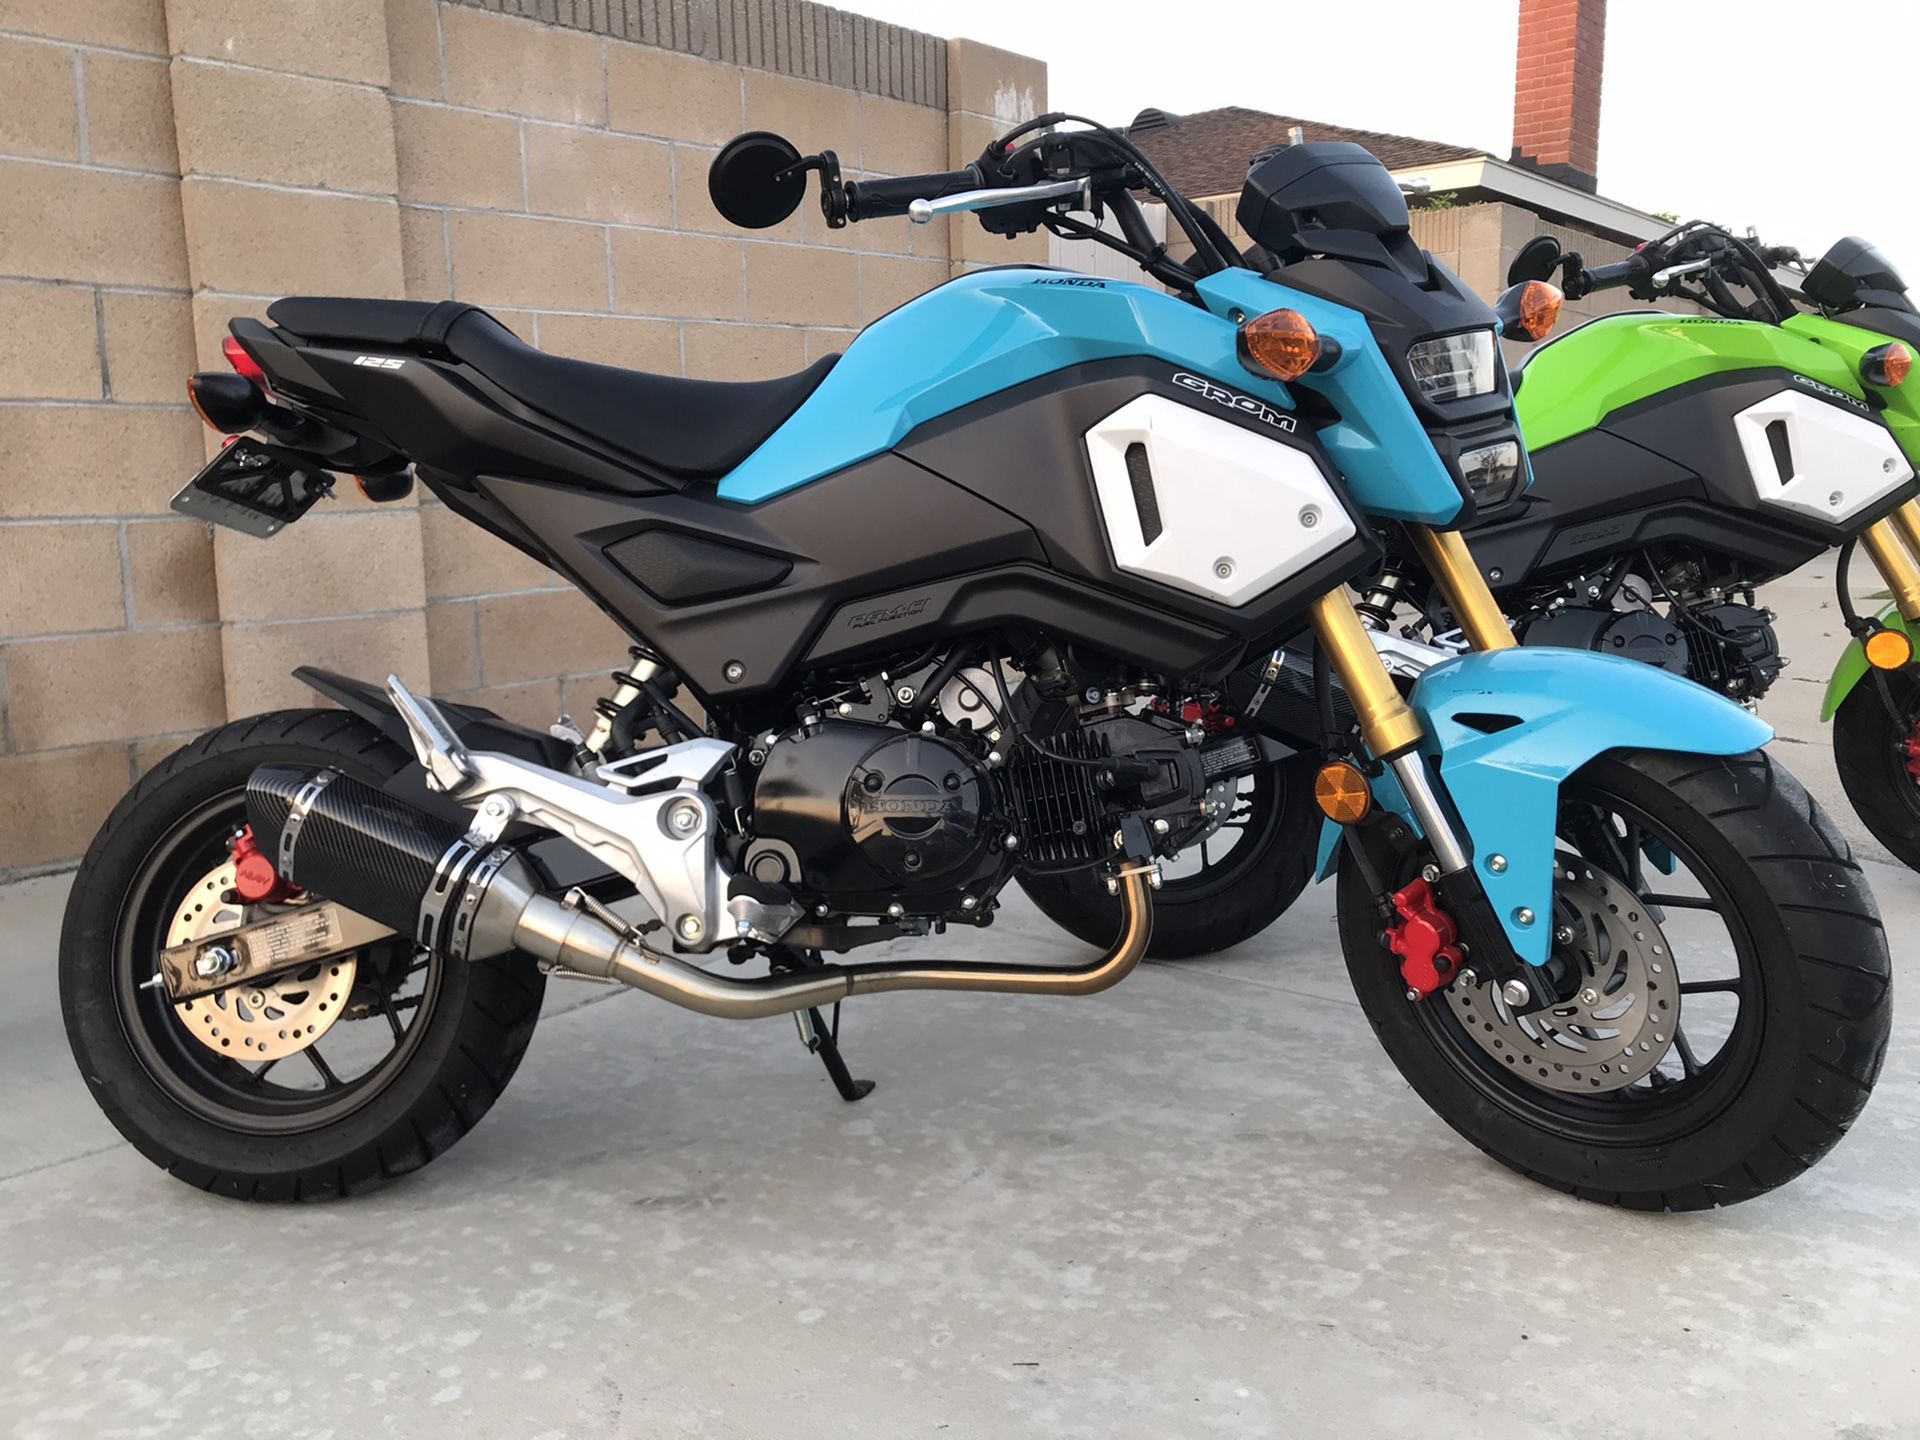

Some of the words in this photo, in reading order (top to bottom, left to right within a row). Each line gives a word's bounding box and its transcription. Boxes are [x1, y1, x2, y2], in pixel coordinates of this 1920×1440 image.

[1031, 278, 1106, 289] HONDA
[353, 355, 406, 370] 125
[1793, 374, 1870, 412] GROM
[1172, 372, 1298, 433] GROM
[863, 799, 962, 814] HONDA
